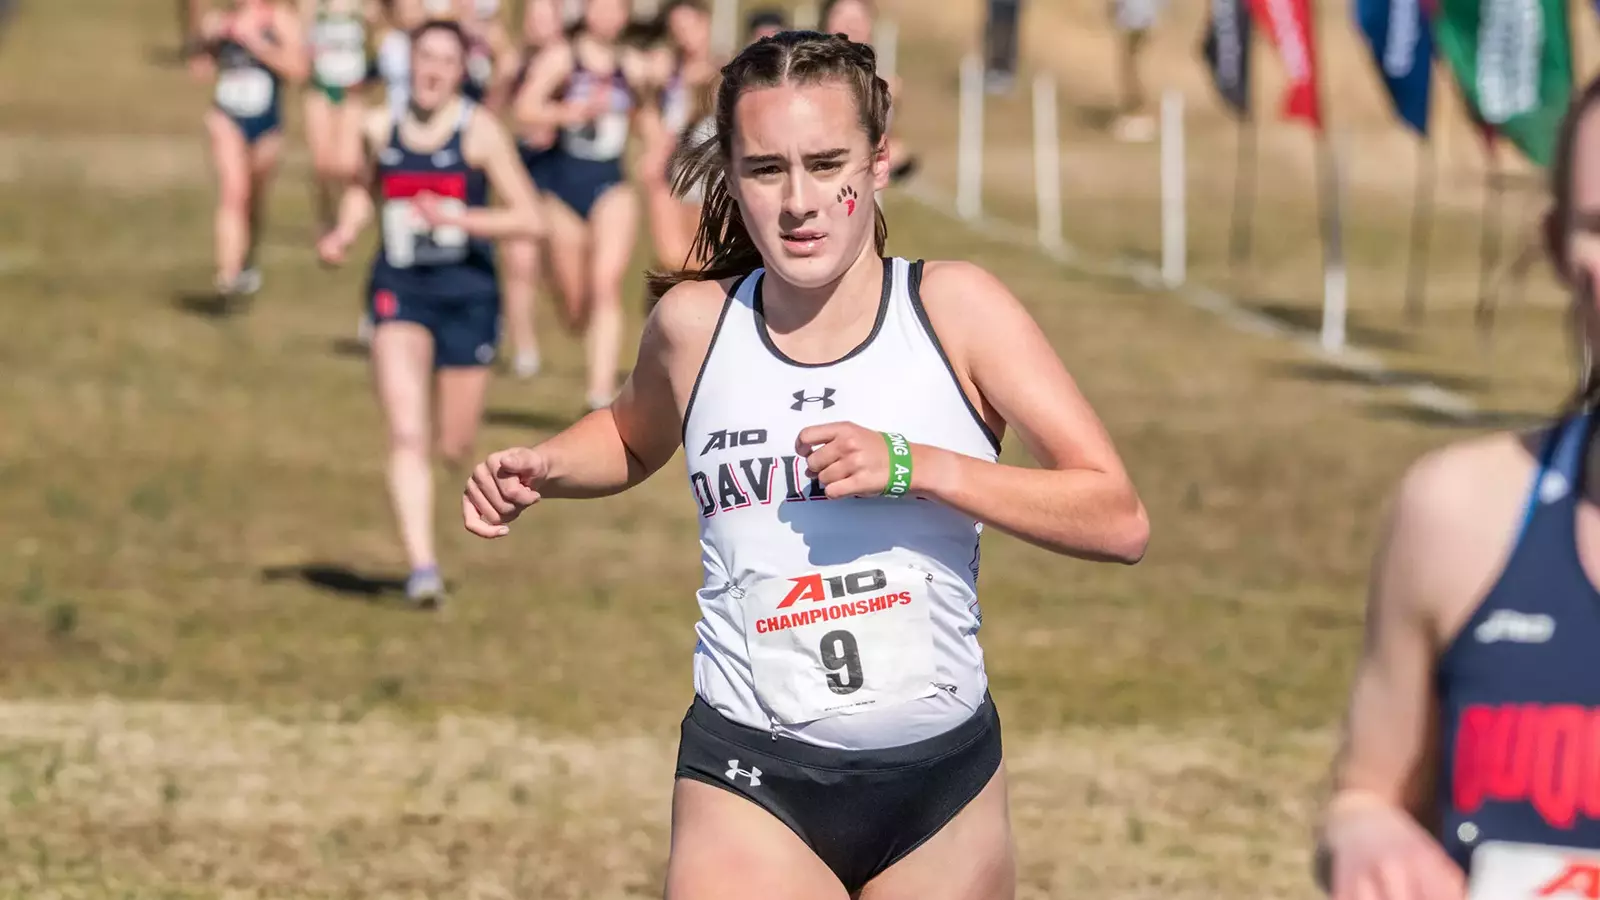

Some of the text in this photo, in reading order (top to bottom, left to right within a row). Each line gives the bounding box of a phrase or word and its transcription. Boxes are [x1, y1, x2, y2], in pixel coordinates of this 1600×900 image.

[700, 429, 767, 456] A10
[887, 432, 910, 494] ONG A-10
[776, 568, 887, 609] A10
[755, 591, 912, 634] CHAMPIONSHIPS
[820, 629, 864, 695] 9
